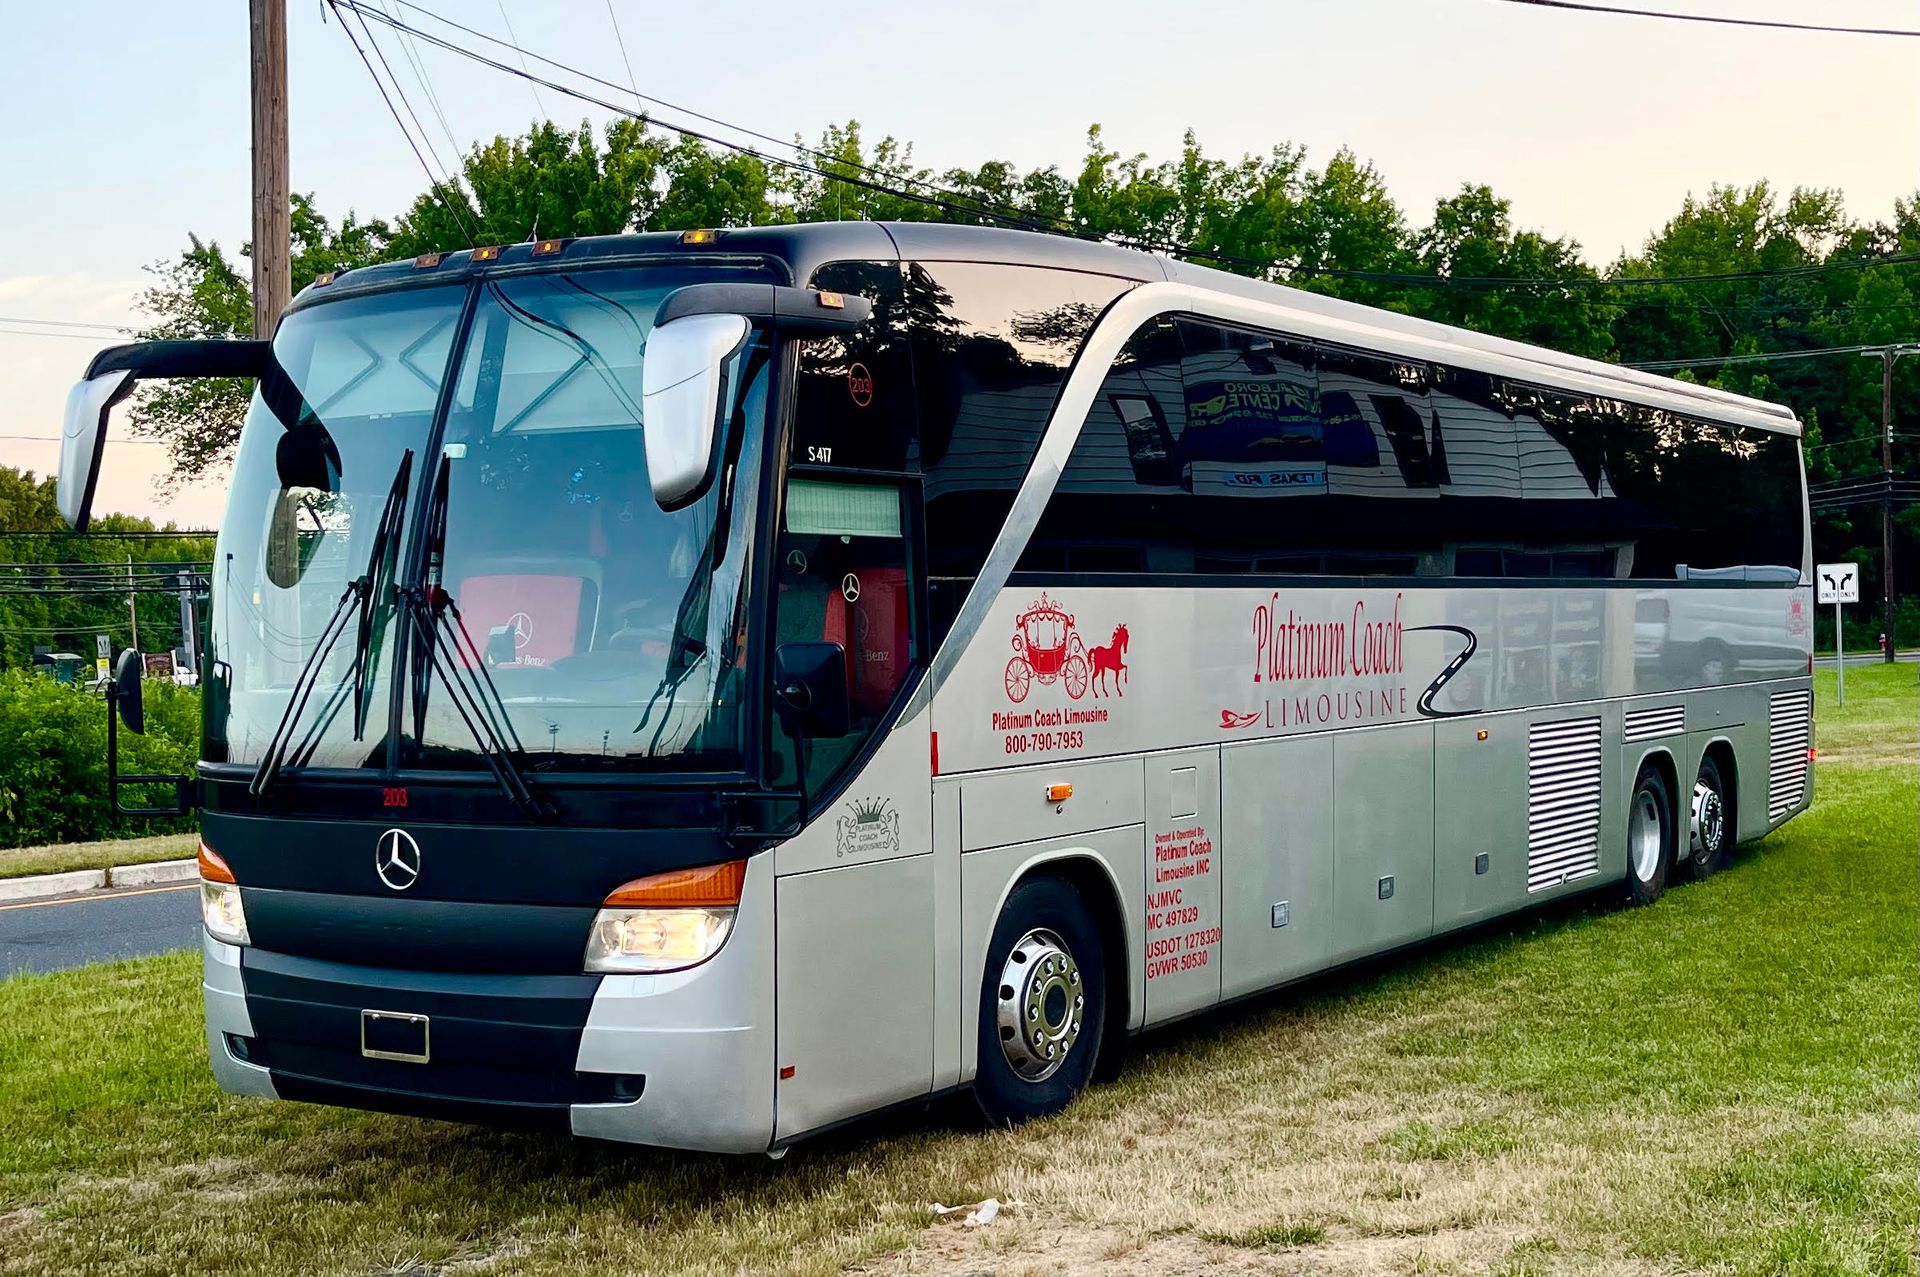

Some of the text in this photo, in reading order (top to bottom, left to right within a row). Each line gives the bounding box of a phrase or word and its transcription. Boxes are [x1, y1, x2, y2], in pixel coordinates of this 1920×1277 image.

[852, 378, 871, 393] 203
[1253, 592, 1402, 682] Platinum Coach
[524, 655, 545, 665] Benz
[992, 706, 1108, 731] Platinum Coach Limousine
[1265, 688, 1407, 728] LIMOUSINE
[1005, 731, 1083, 754] 800-790-7953
[383, 787, 408, 807] 203
[1155, 833, 1171, 843] Owned
[1156, 837, 1211, 862] Platinum Coach
[1156, 858, 1209, 882] Limousine INC
[1147, 889, 1182, 910] NJMVC
[1147, 907, 1198, 930] MC 497829
[1146, 927, 1222, 958] USDOT 1278320
[1147, 950, 1207, 979] GVWR 50530
